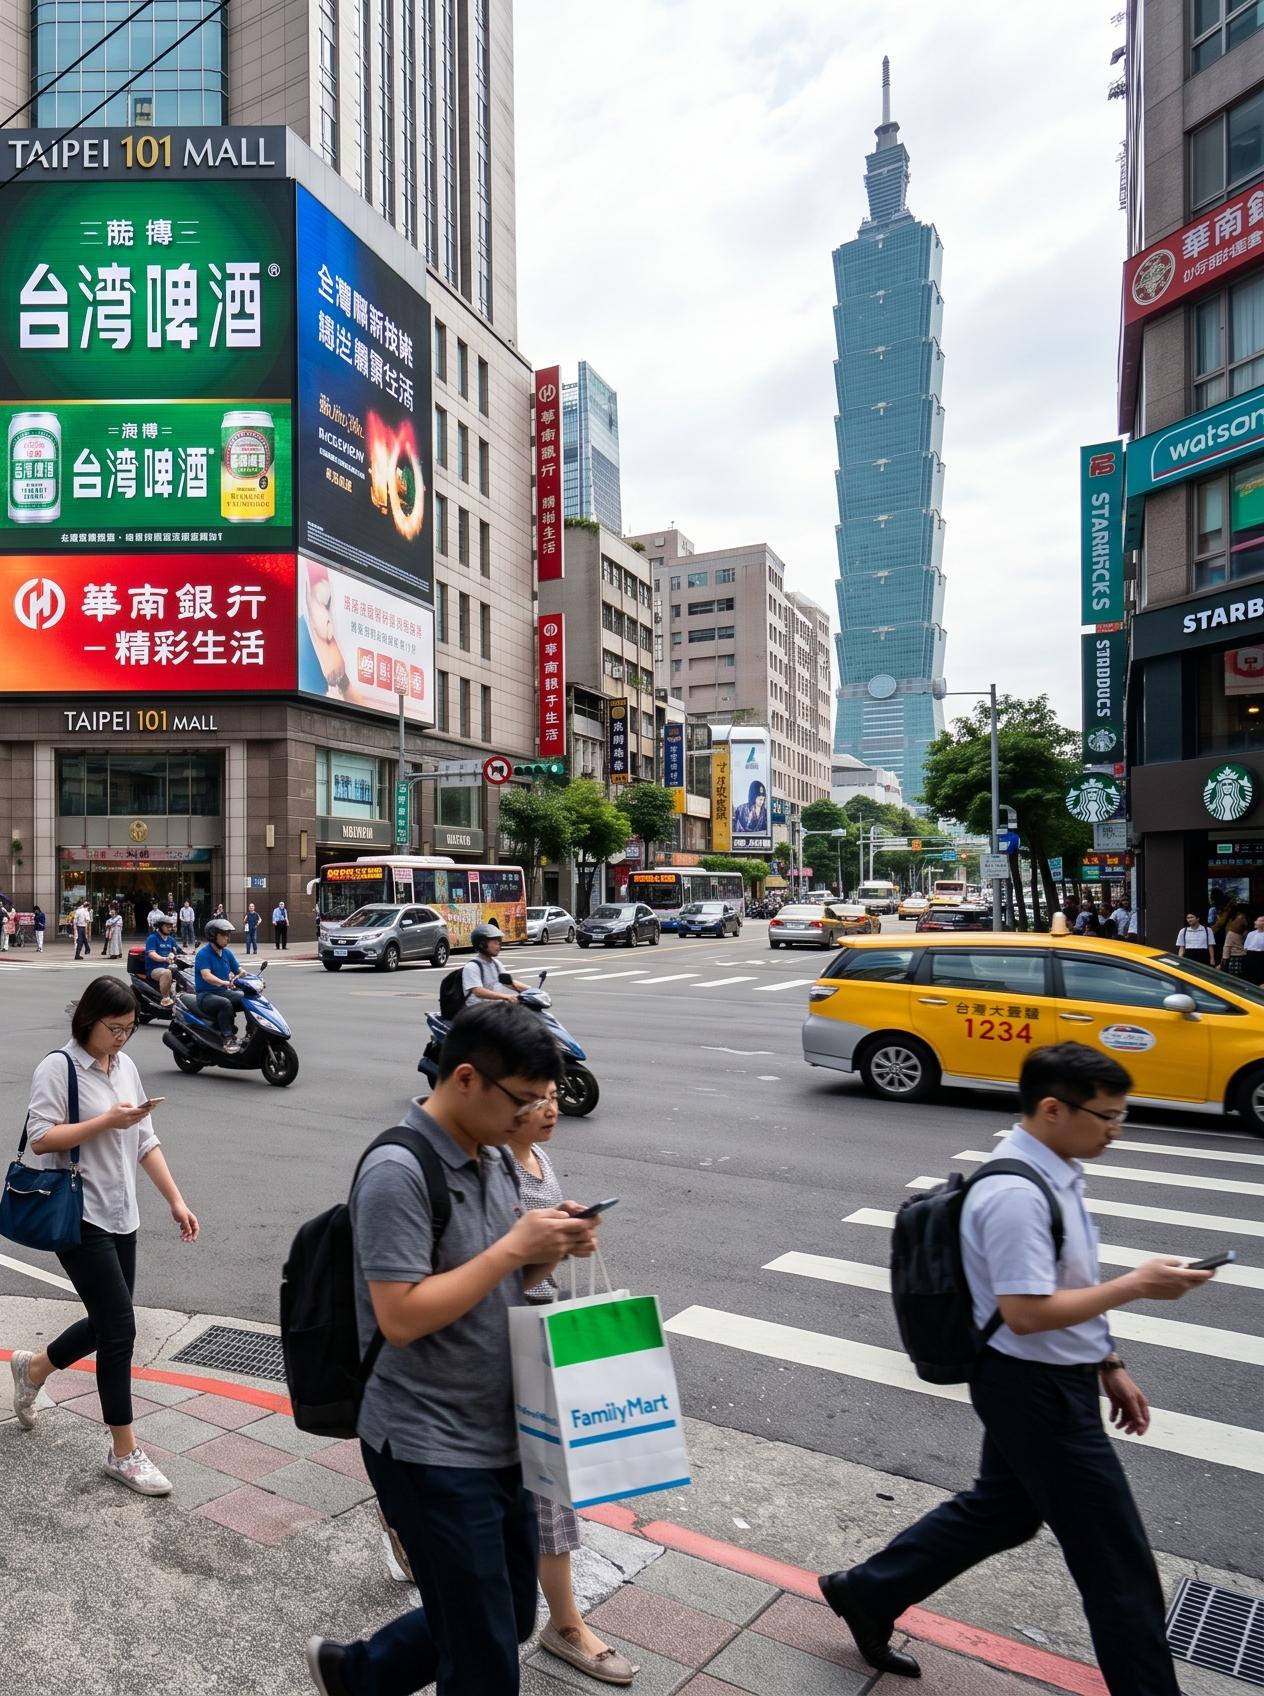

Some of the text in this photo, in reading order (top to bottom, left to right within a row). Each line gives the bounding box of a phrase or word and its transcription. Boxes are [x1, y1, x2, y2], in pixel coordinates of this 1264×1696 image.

[8, 135, 275, 169] TAIPEI 101 MALL
[81, 583, 266, 621] 華南銀行
[64, 710, 218, 731] TAIPEI 101 MALL
[964, 1017, 1033, 1044] 1234
